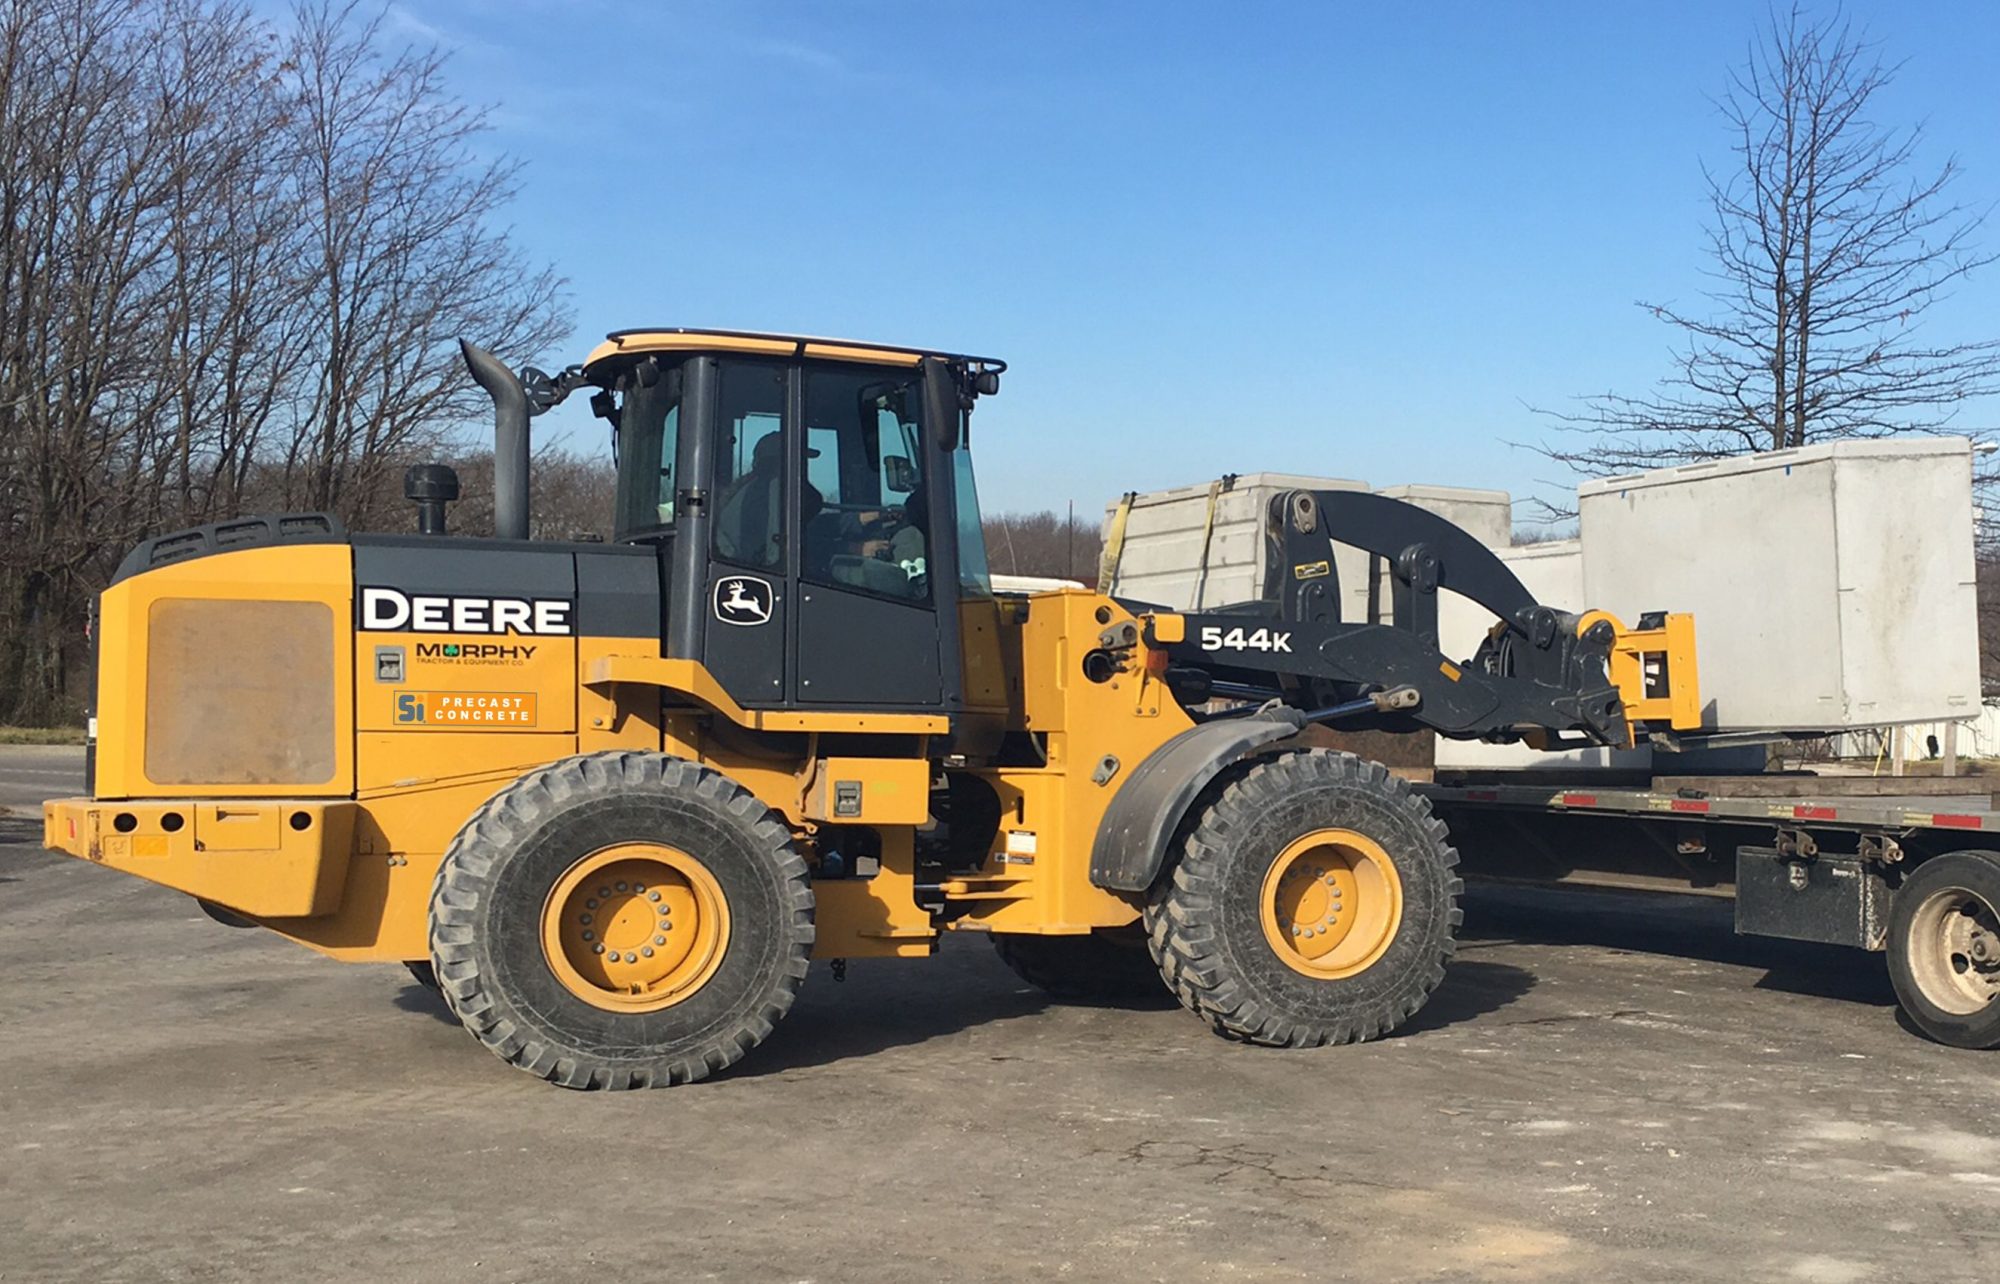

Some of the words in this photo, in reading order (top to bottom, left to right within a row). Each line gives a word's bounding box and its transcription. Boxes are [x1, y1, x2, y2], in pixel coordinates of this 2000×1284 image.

[363, 588, 570, 633] DEERE
[1201, 627, 1292, 652] 544K
[442, 697, 522, 708] PRECAST
[435, 709, 529, 721] CONCRETE
